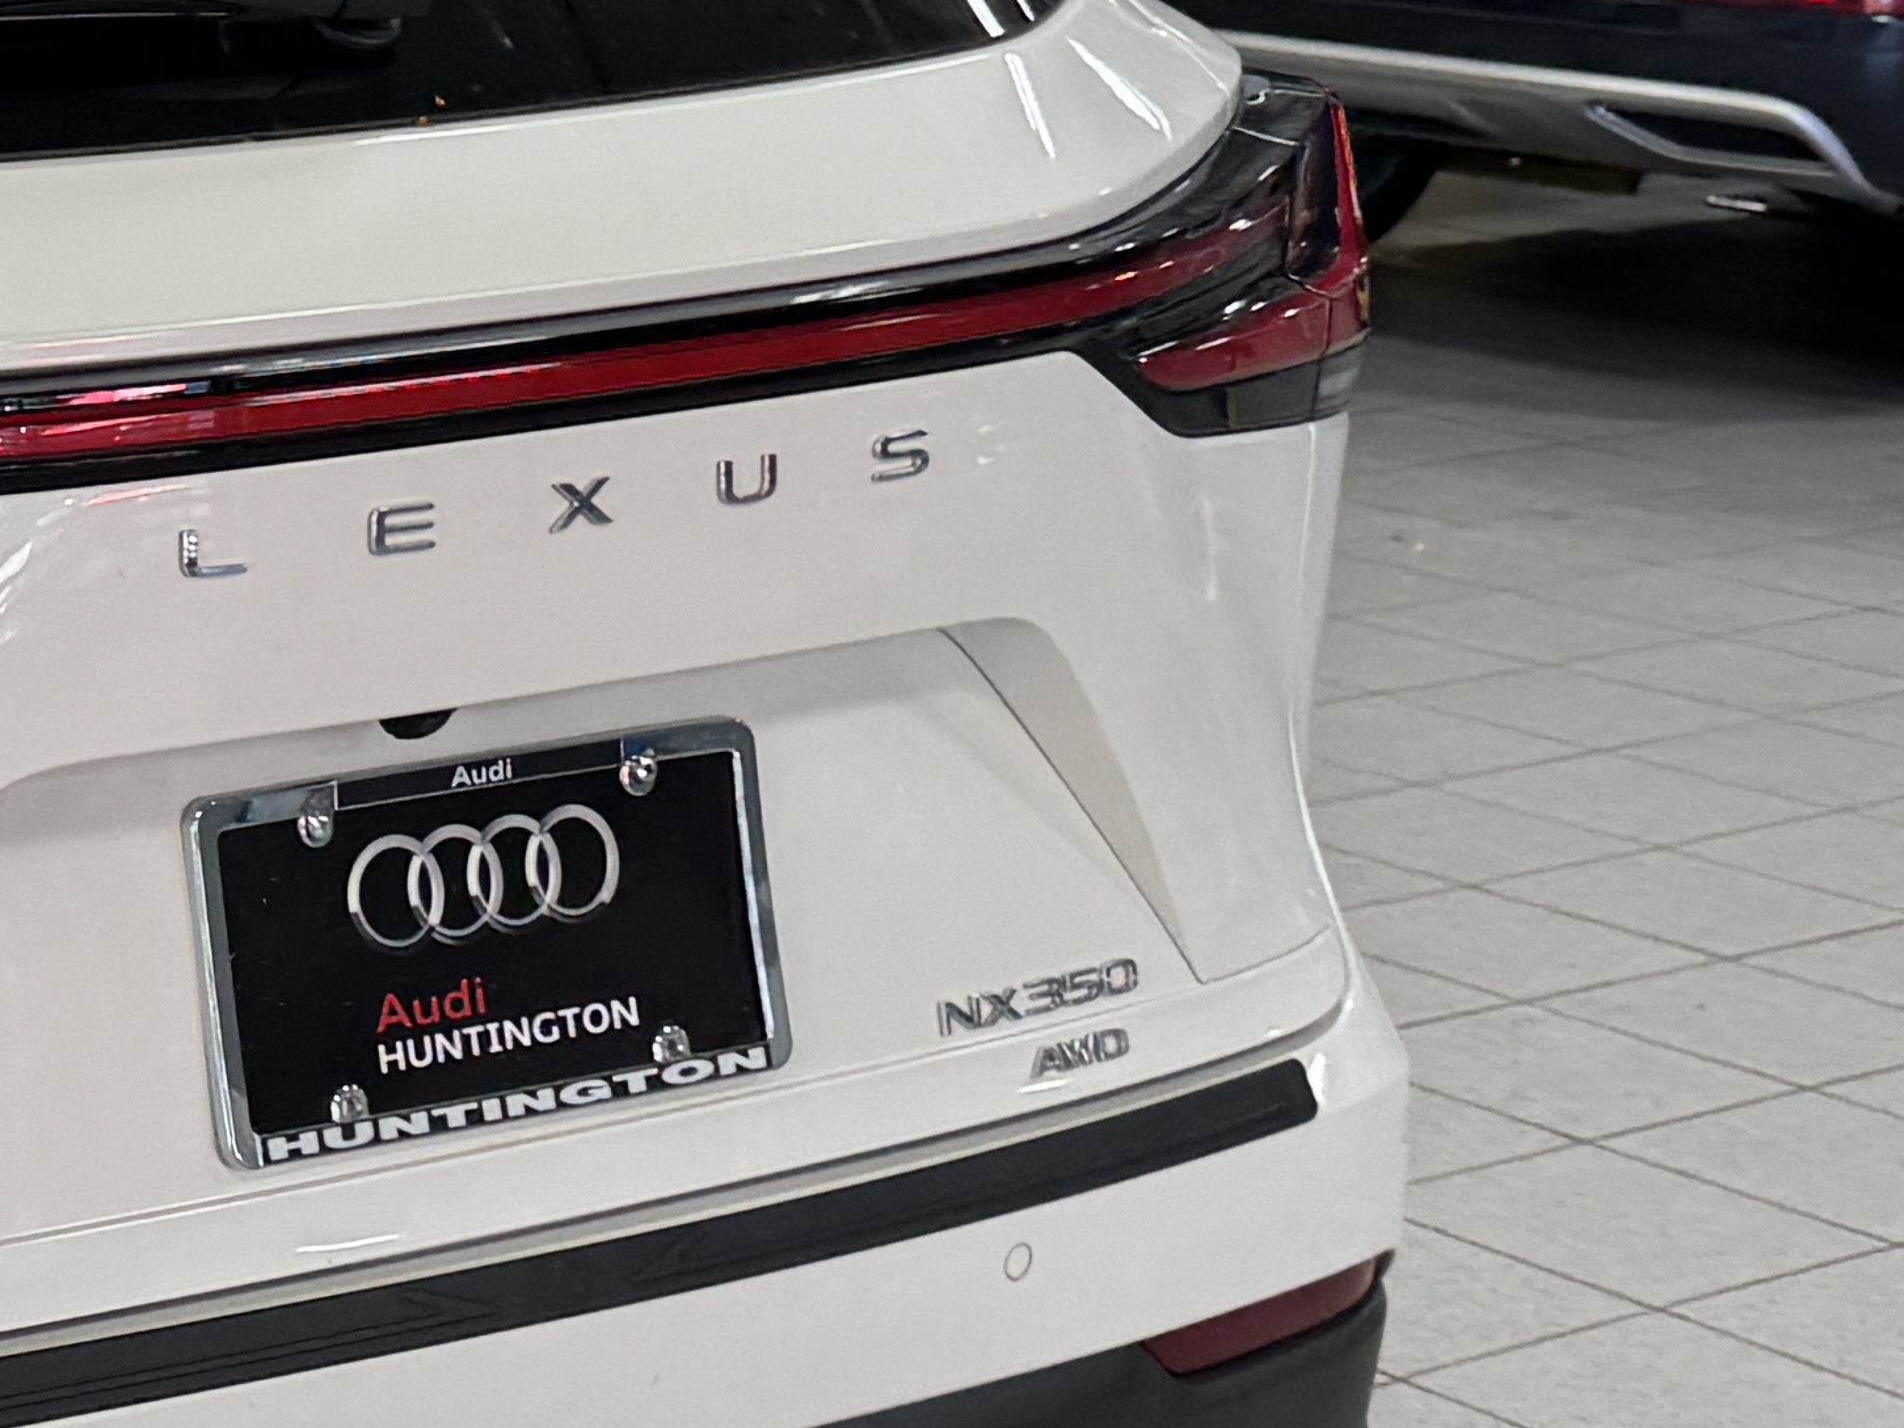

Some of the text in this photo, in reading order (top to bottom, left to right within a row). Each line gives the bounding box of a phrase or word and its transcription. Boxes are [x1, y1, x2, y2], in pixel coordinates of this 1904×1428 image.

[178, 428, 929, 577] LEXUS
[451, 758, 513, 788] Audi
[376, 976, 487, 1034] Audi
[378, 996, 640, 1073] HUNTINGTON
[936, 958, 1138, 1037] NX350
[1029, 1028, 1130, 1080] AWD
[268, 1046, 770, 1161] HUNTINGTON
